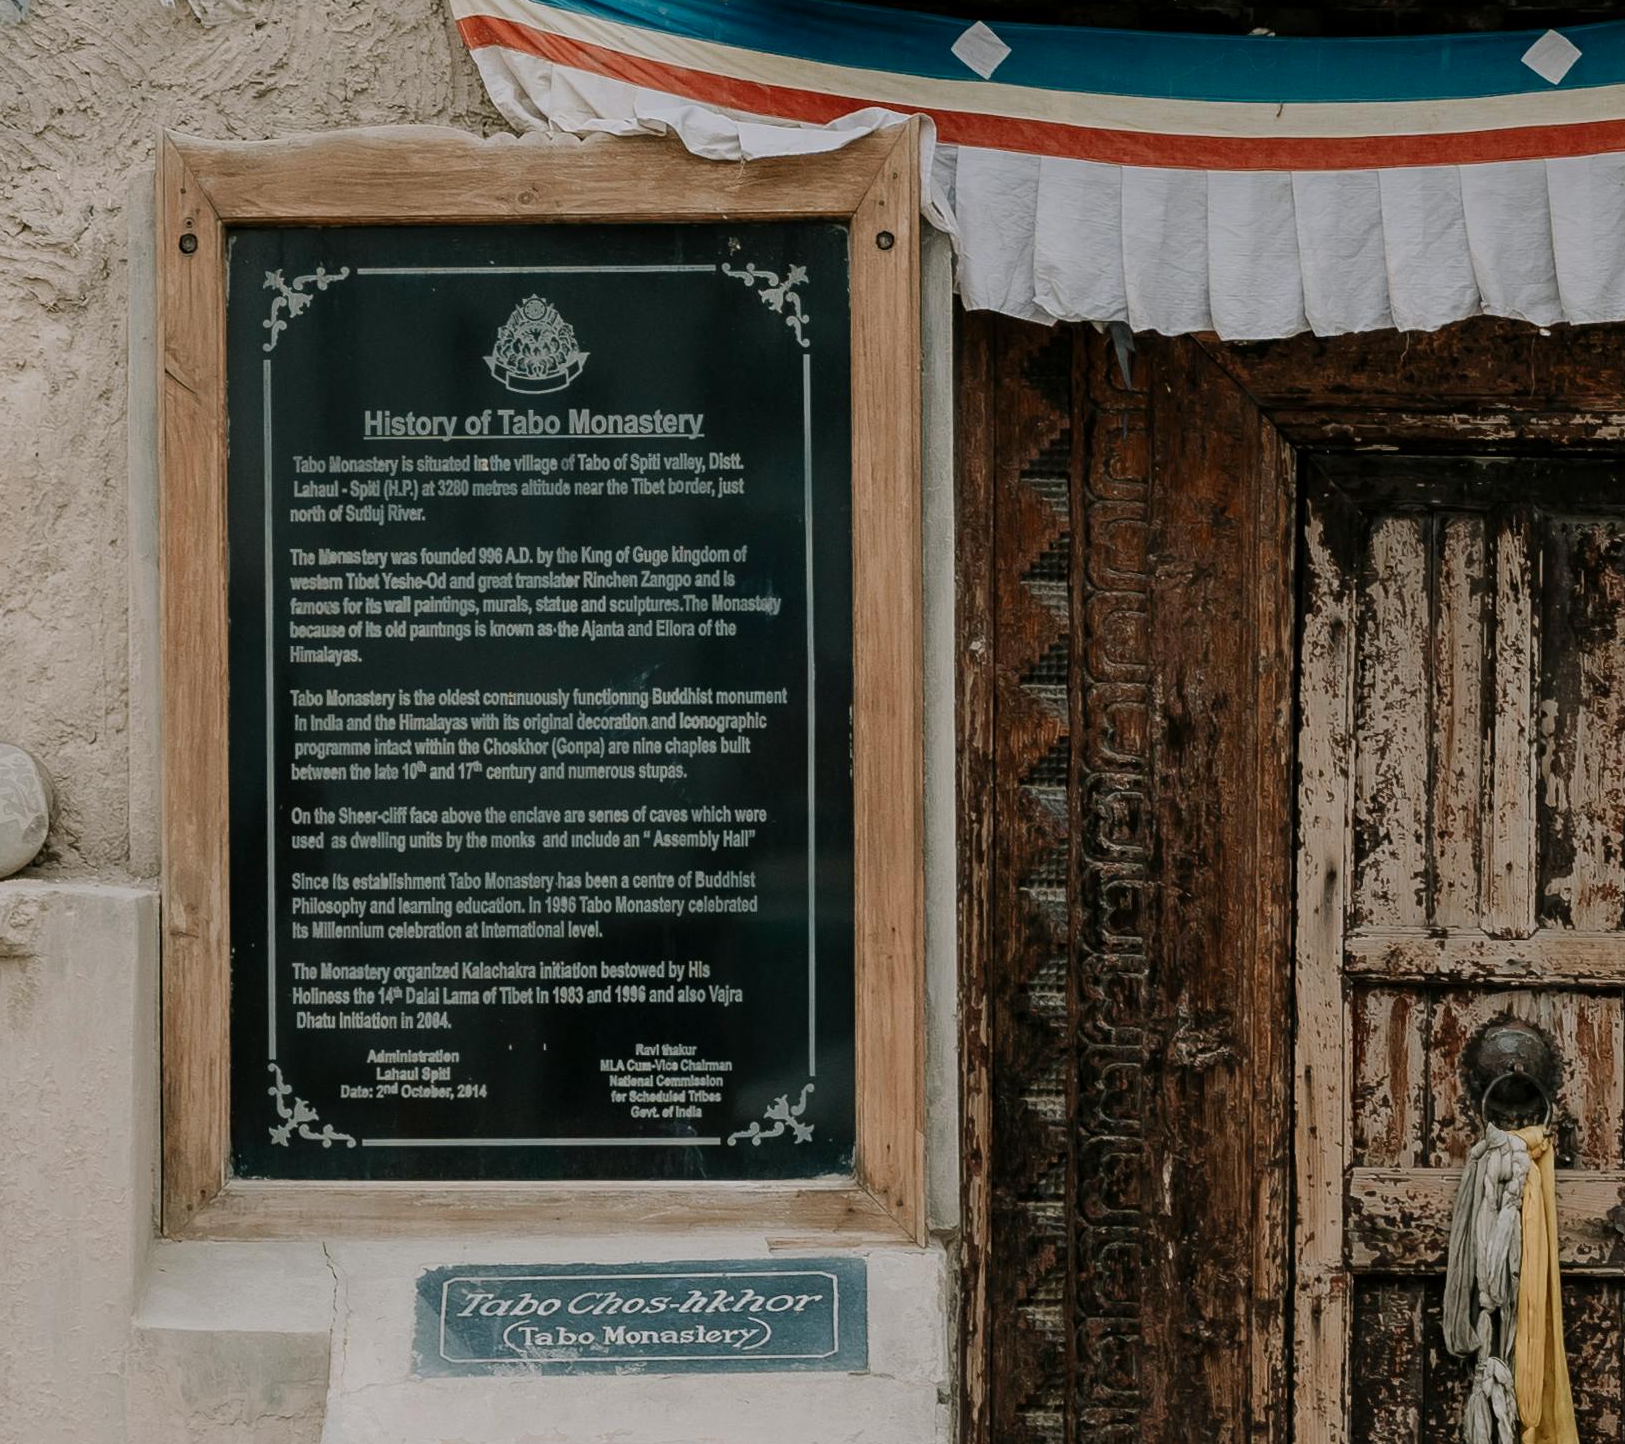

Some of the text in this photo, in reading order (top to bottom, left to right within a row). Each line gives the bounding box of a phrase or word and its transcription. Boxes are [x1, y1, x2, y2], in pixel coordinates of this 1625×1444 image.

[365, 409, 703, 441] History of Tabo Monastery
[293, 456, 326, 473] Tabo
[329, 455, 399, 476] Monastery
[417, 455, 470, 472] situated
[514, 454, 558, 475] village
[577, 454, 610, 470] Tabo
[664, 453, 705, 474] valley,
[294, 481, 338, 497] Lahaul
[473, 480, 518, 496] metres
[631, 478, 665, 495] Tibet
[668, 478, 715, 497] border,
[290, 505, 326, 522] north
[388, 504, 425, 521] River.
[319, 545, 729, 570] Monastery founded kingdom
[346, 573, 380, 590] Tibet
[382, 572, 446, 589] Yeshe-Od
[478, 573, 513, 593] great
[583, 571, 638, 588] Rinchen
[641, 571, 691, 592] Zangpo
[414, 595, 479, 617] paintings,
[483, 595, 532, 615] murals,
[536, 595, 578, 612] statue
[290, 621, 345, 638] because
[490, 620, 534, 637] known
[581, 620, 624, 641] Ajanta
[656, 620, 694, 636] Ellora
[290, 646, 362, 667] Himalayas.
[290, 690, 323, 706] Tabo
[326, 690, 395, 711] Monastery
[438, 689, 480, 706] oldest
[652, 688, 713, 705] Buddhist
[716, 688, 787, 704] monument
[399, 713, 468, 734] Himalayas
[523, 713, 573, 734] original
[295, 743, 371, 760] programme
[374, 738, 412, 755] intact
[414, 738, 455, 755] within
[483, 738, 549, 755] Choskhor
[552, 737, 605, 758] (Gonpa)
[292, 763, 346, 780] between
[486, 764, 536, 784] century
[568, 766, 635, 779] numerous
[639, 763, 687, 783] stupas.
[441, 807, 482, 824] above
[509, 806, 561, 823] enclave
[649, 810, 688, 822] caves
[691, 805, 731, 822] which
[350, 831, 406, 852] dwelling
[409, 831, 442, 848] units
[491, 831, 535, 848] monks
[571, 830, 620, 847] include
[653, 830, 720, 851] Assembly
[292, 873, 329, 890] Since
[448, 872, 481, 889] Tabo
[485, 872, 554, 892] Monastery
[633, 873, 674, 888] centre
[695, 871, 755, 887] Buddhist
[293, 897, 367, 918] Philosophy
[456, 897, 525, 914] education.
[545, 896, 576, 913] 1996
[579, 896, 612, 913] Tabo
[615, 896, 684, 917] Monastery
[689, 895, 757, 912] celebrated
[388, 921, 461, 939] celebration
[568, 920, 602, 937] level.
[321, 963, 391, 985] Monastery
[462, 962, 536, 979] Kalachakra
[540, 961, 597, 978] initiation
[601, 961, 664, 978] bestowed
[293, 987, 350, 1004] Holiness
[499, 987, 533, 1004] Tibet
[553, 986, 583, 1003] 1983
[615, 985, 646, 1002] 1996
[709, 985, 742, 1006] Vajra
[297, 1012, 335, 1029] Dhatu
[455, 1288, 824, 1317] Tabo Chos-hkhor
[502, 1317, 772, 1352] (Tabo Monastery)
